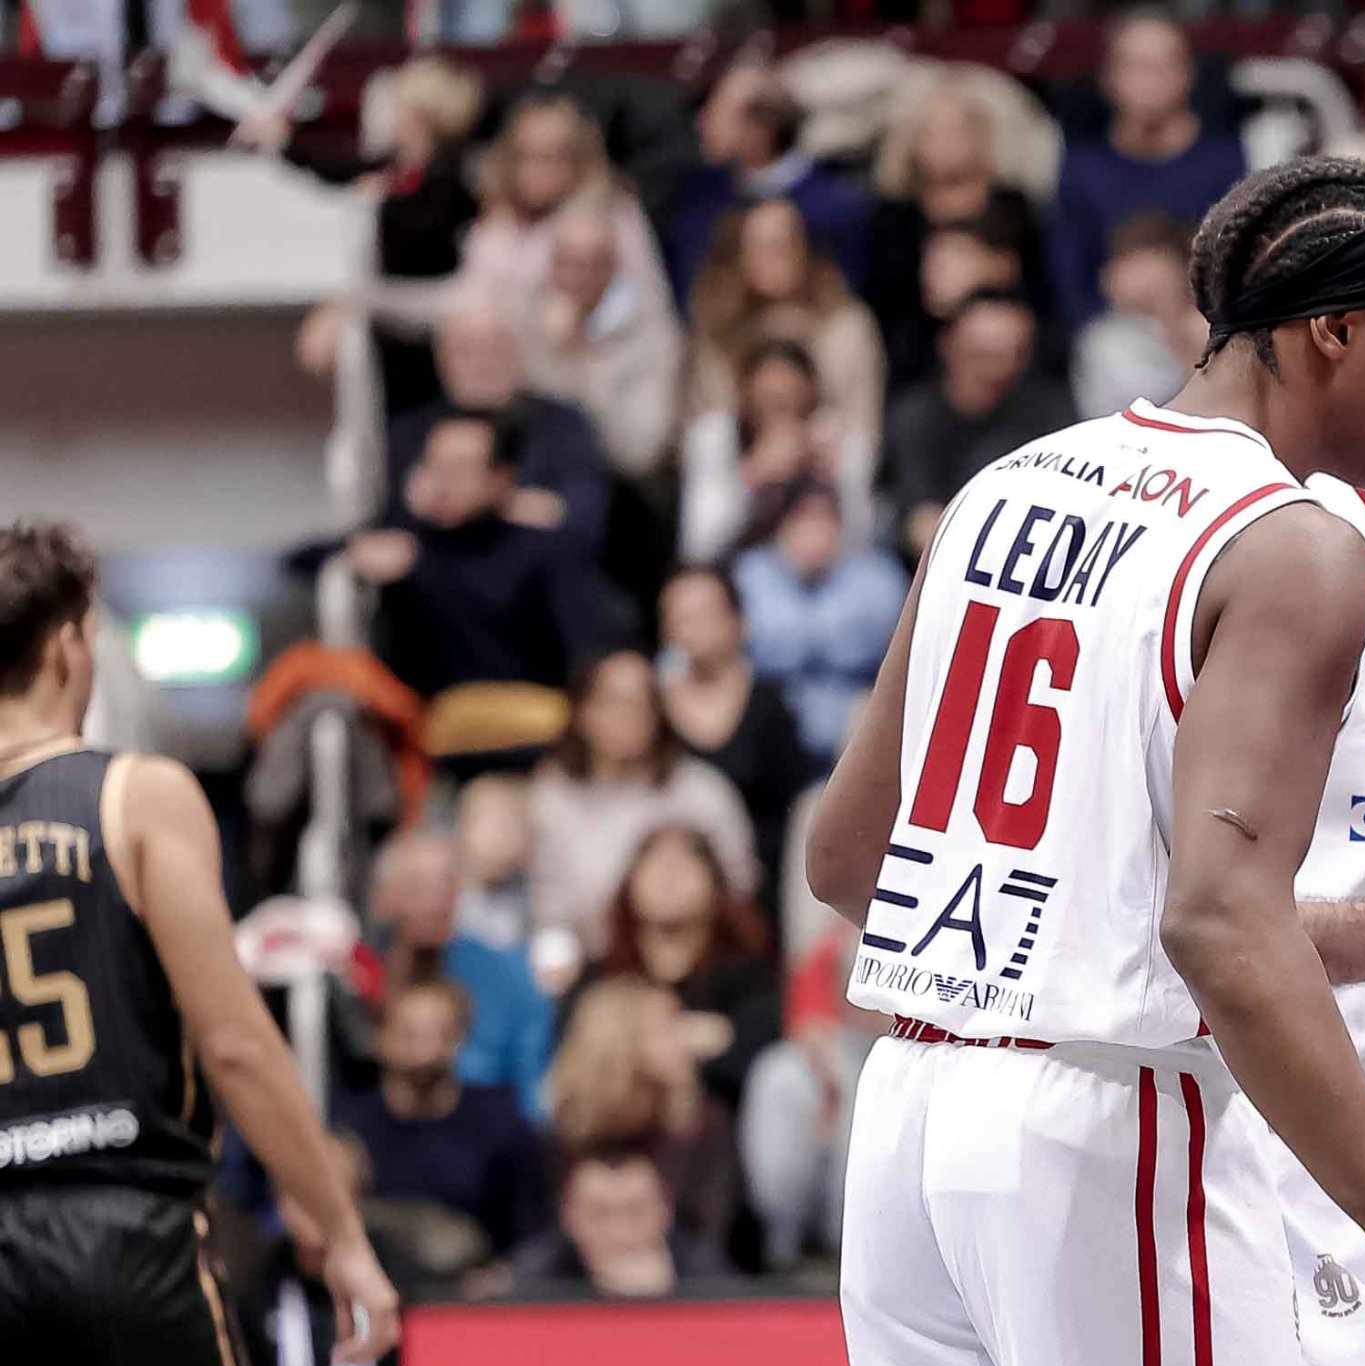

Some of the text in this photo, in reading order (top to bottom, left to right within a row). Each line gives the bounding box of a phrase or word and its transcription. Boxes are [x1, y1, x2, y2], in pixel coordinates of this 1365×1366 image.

[1108, 464, 1209, 518] AON
[964, 499, 1147, 608] LEDAY
[909, 599, 1081, 851] 16
[862, 843, 1058, 981] EA7
[0, 898, 97, 1084] 5
[857, 955, 934, 997] MPORIO
